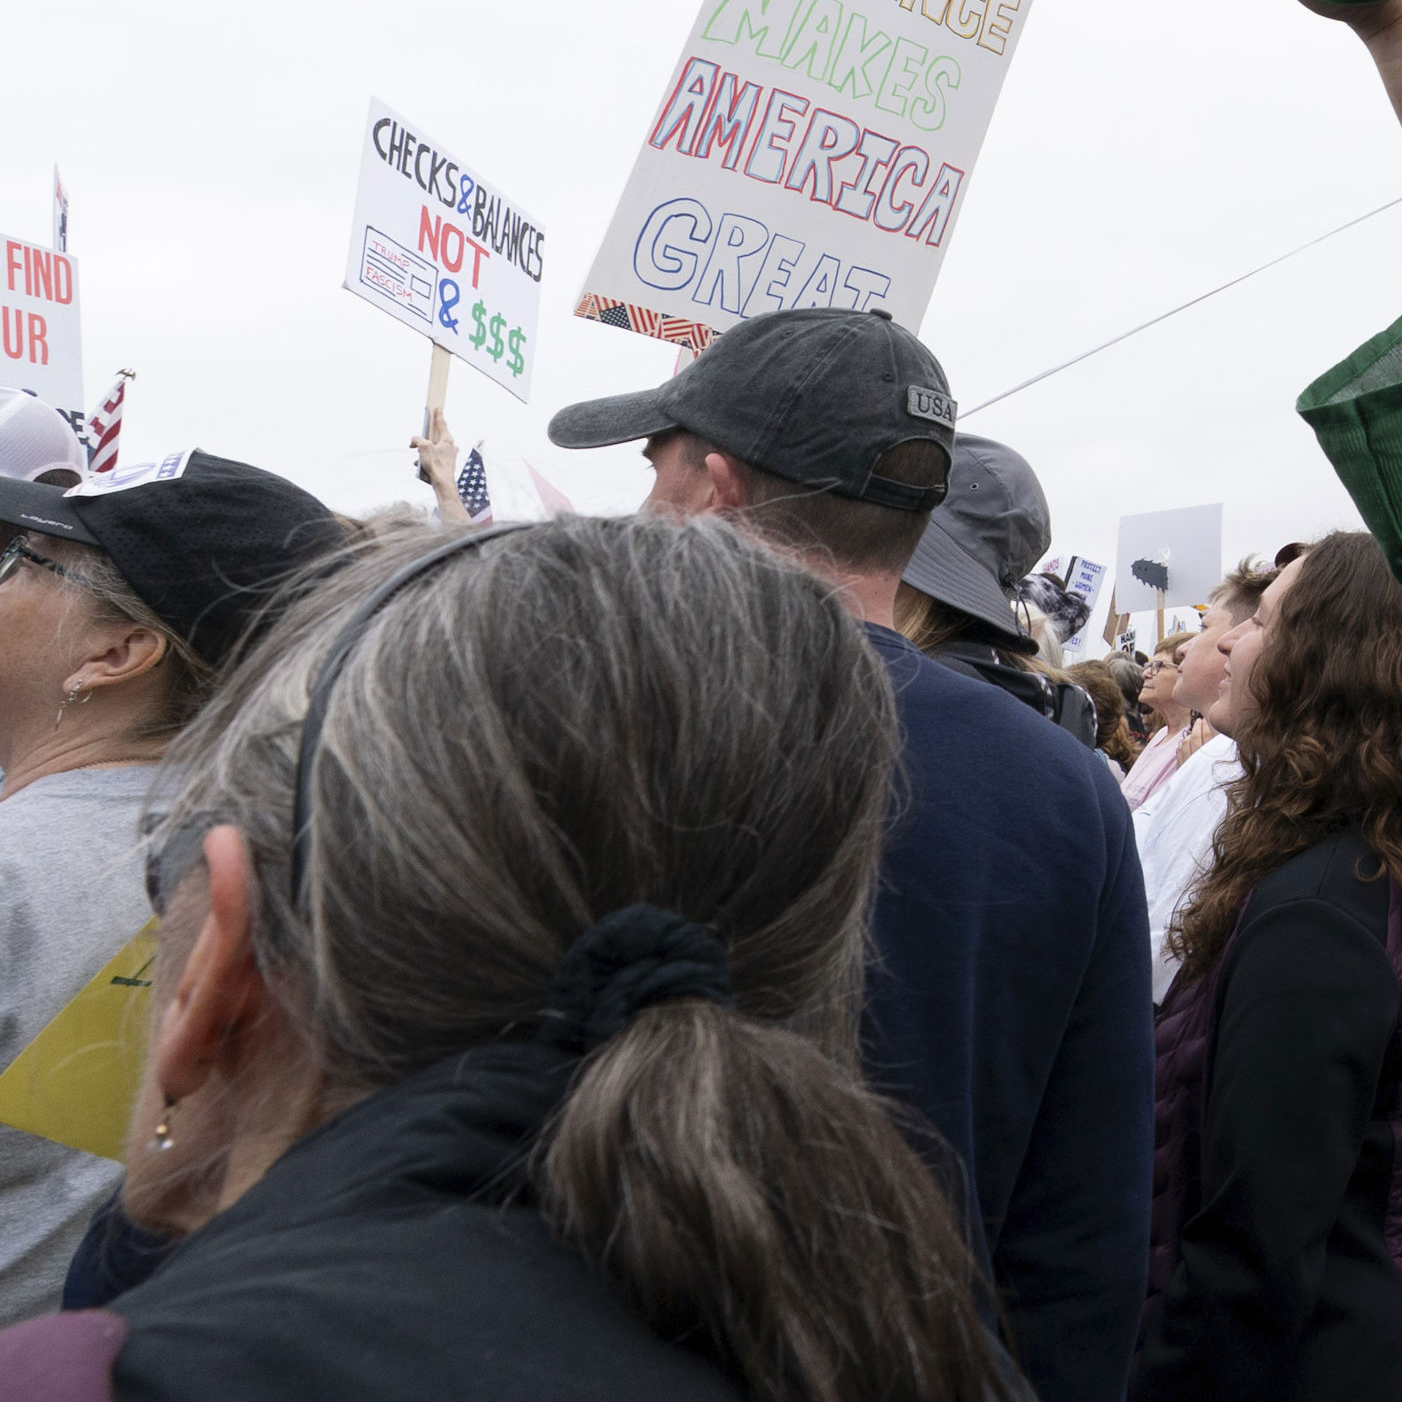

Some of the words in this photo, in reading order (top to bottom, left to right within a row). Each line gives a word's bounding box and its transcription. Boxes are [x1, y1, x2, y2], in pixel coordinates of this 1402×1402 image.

[649, 56, 965, 248] AMERICA
[373, 118, 458, 208] CHECKS
[457, 174, 475, 220] &
[472, 185, 544, 283] BALANCES
[6, 240, 73, 305] FIND
[366, 267, 413, 303] FASCISM
[372, 241, 410, 269] TRUMP
[418, 205, 490, 290] NOT
[633, 198, 891, 319] GREAT
[439, 278, 460, 335] &
[469, 300, 527, 378] $$$
[917, 393, 953, 422] USA
